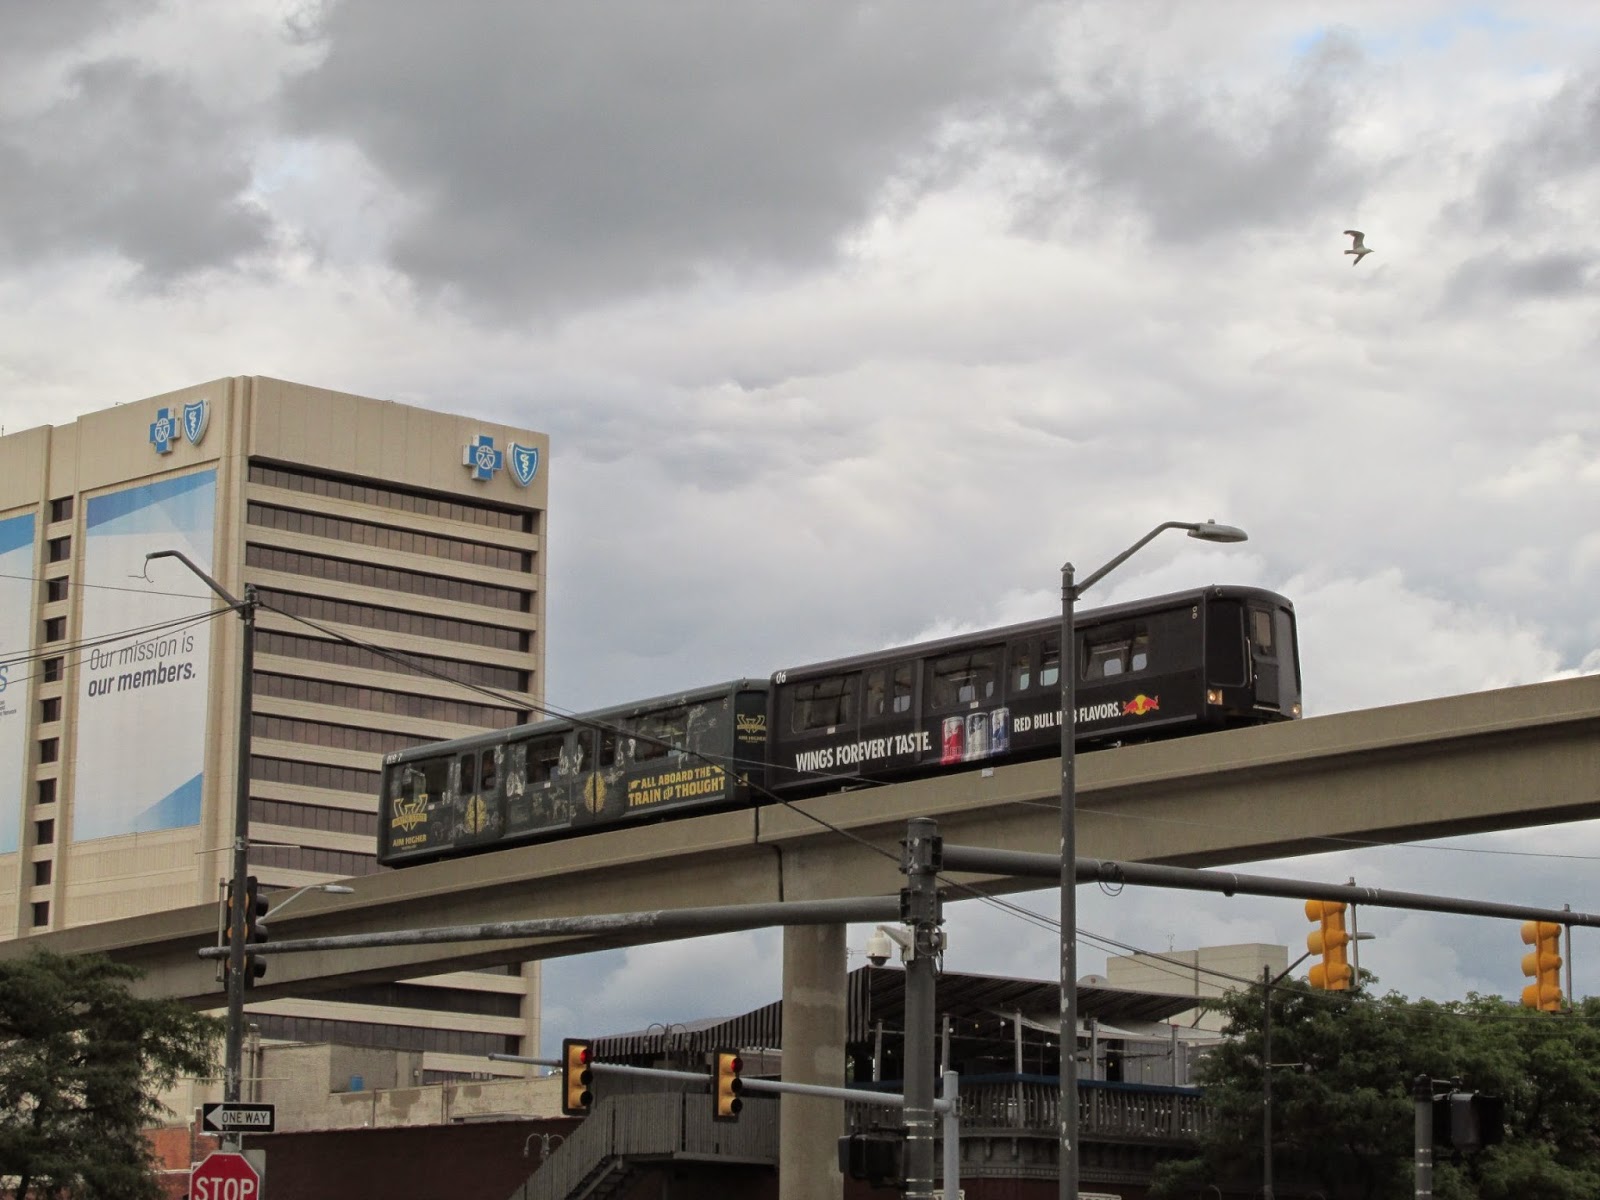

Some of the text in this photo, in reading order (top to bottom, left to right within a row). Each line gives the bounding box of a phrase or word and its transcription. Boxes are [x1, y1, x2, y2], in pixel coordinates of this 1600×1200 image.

[90, 631, 194, 670] Our mission is
[88, 661, 196, 697] our members.
[776, 671, 787, 684] 06
[1014, 717, 1031, 732] RED
[1034, 712, 1054, 729] BULL
[1079, 701, 1122, 722] FLAVORS.
[795, 747, 833, 772] WINGS
[895, 731, 932, 755] TASTE.
[641, 766, 711, 788] ALL ABOARD THE
[628, 789, 661, 806] TRAIN
[675, 777, 725, 798] THOUGHT
[393, 839, 404, 847] AIM
[405, 834, 427, 845] HIGHER
[222, 1112, 267, 1123] ONE WAY
[194, 1176, 254, 1200] STOP
